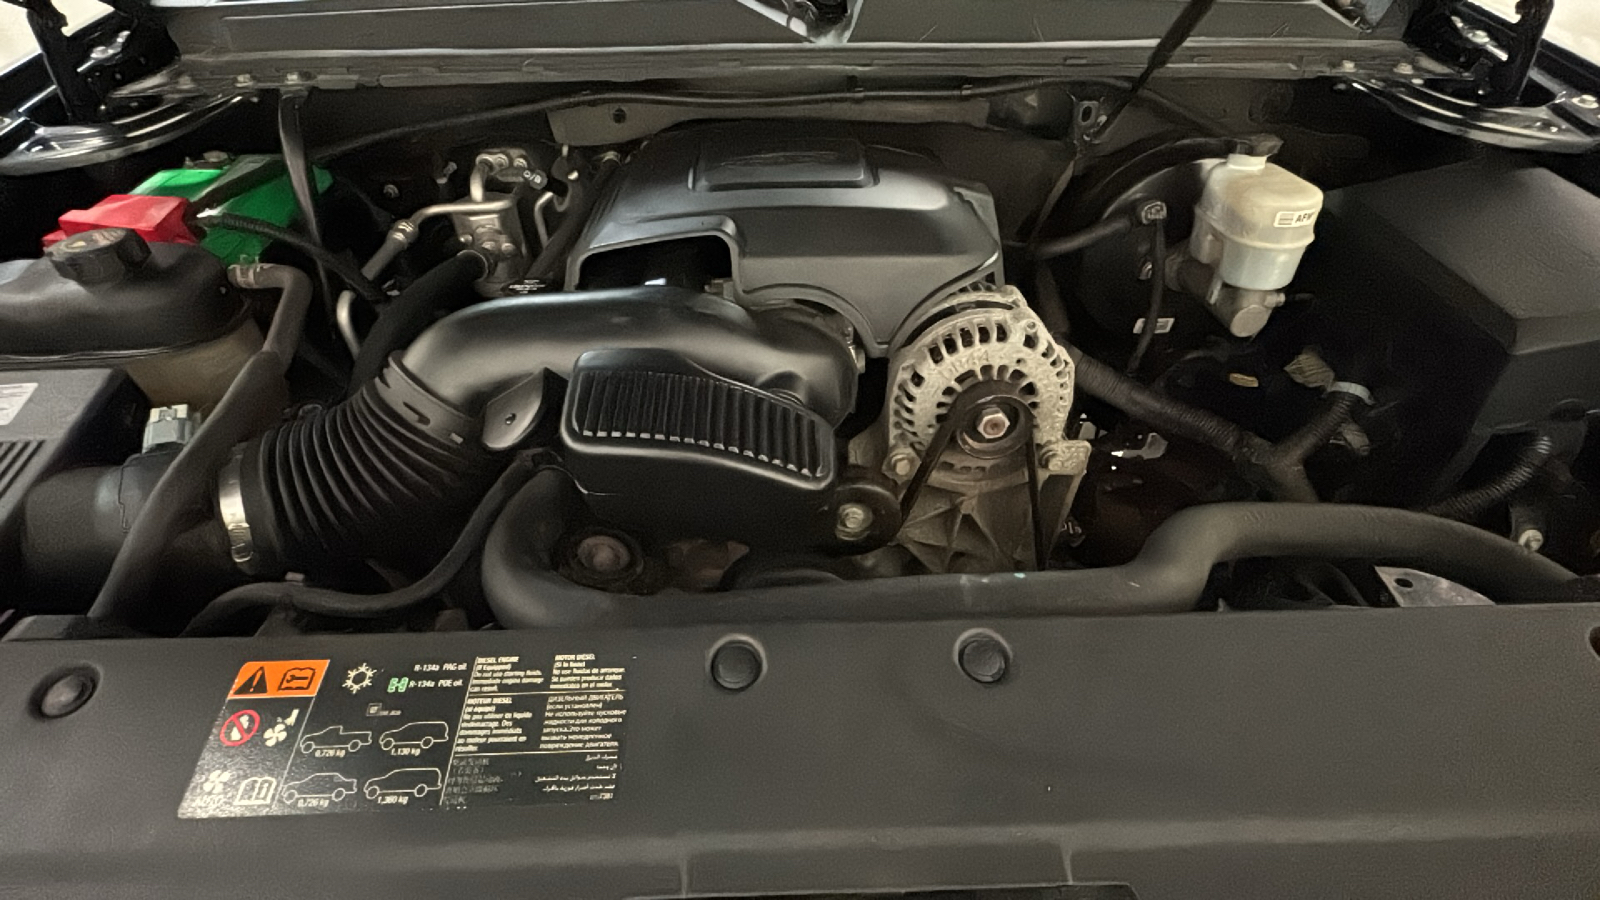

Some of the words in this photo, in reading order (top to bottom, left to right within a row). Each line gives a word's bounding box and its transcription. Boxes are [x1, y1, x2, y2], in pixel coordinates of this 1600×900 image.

[336, 750, 346, 758] kg
[410, 748, 421, 756] kg
[319, 799, 330, 808] kg
[399, 796, 409, 805] kg
